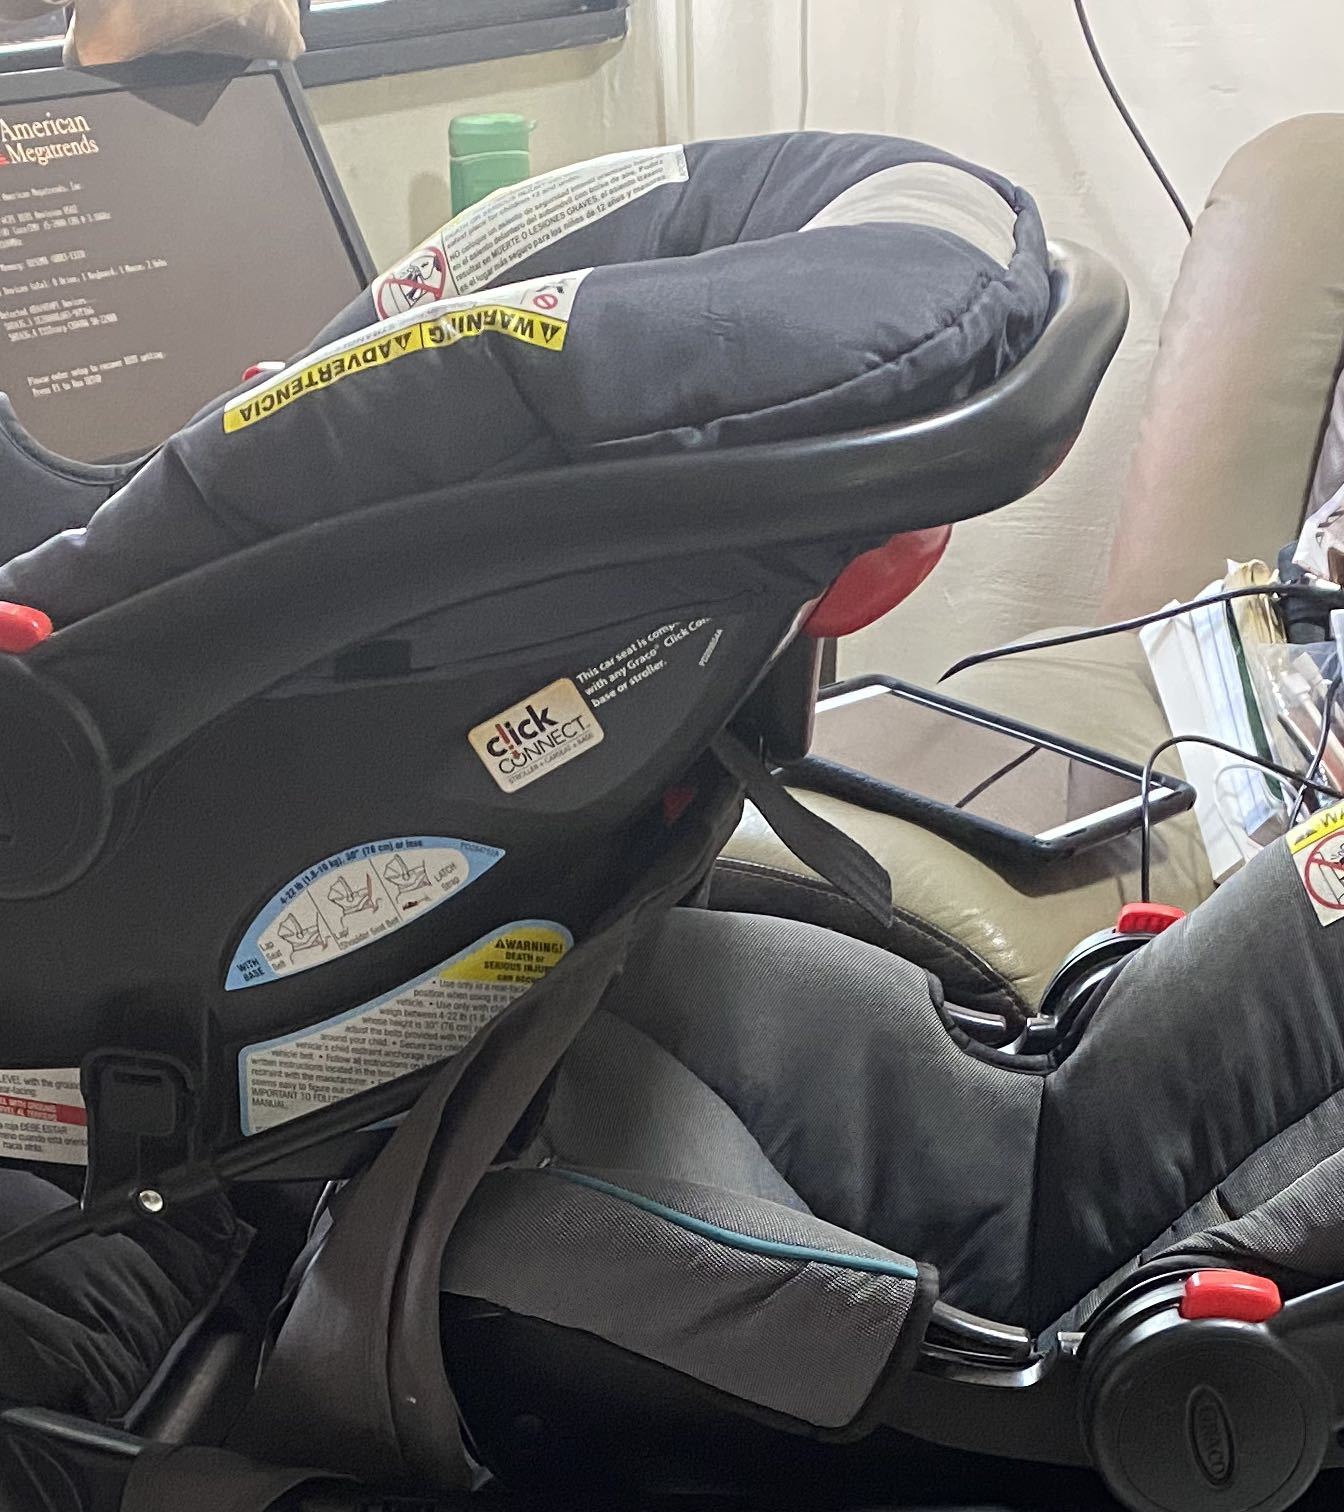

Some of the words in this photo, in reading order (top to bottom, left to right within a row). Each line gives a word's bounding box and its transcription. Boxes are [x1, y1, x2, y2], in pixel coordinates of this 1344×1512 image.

[0, 113, 90, 143] American
[6, 135, 98, 166] Megatrends
[595, 202, 606, 213] 12
[488, 234, 522, 258] MUERTE
[520, 230, 528, 240] O
[526, 210, 567, 236] LESIONES
[428, 306, 535, 345] WARNING
[239, 341, 392, 422] ADVERTENCIA
[575, 664, 600, 684] This
[597, 656, 616, 671] car
[613, 642, 638, 661] seat
[635, 636, 648, 648] is
[583, 676, 609, 696] with
[606, 665, 628, 683] any
[662, 626, 690, 648] Click
[589, 686, 617, 707] base
[614, 680, 628, 692] or
[626, 656, 669, 685] stroller.
[486, 705, 559, 758] click
[431, 861, 458, 882] LATCH
[504, 951, 533, 960] DEATH
[505, 938, 563, 953] WARNING!
[235, 955, 259, 973] WITH
[242, 965, 265, 982] BASE
[483, 960, 521, 971] SERIOUS
[251, 1088, 298, 1101] IMPORTANT
[300, 1091, 311, 1101] TO
[1197, 1401, 1227, 1476] GRACO
